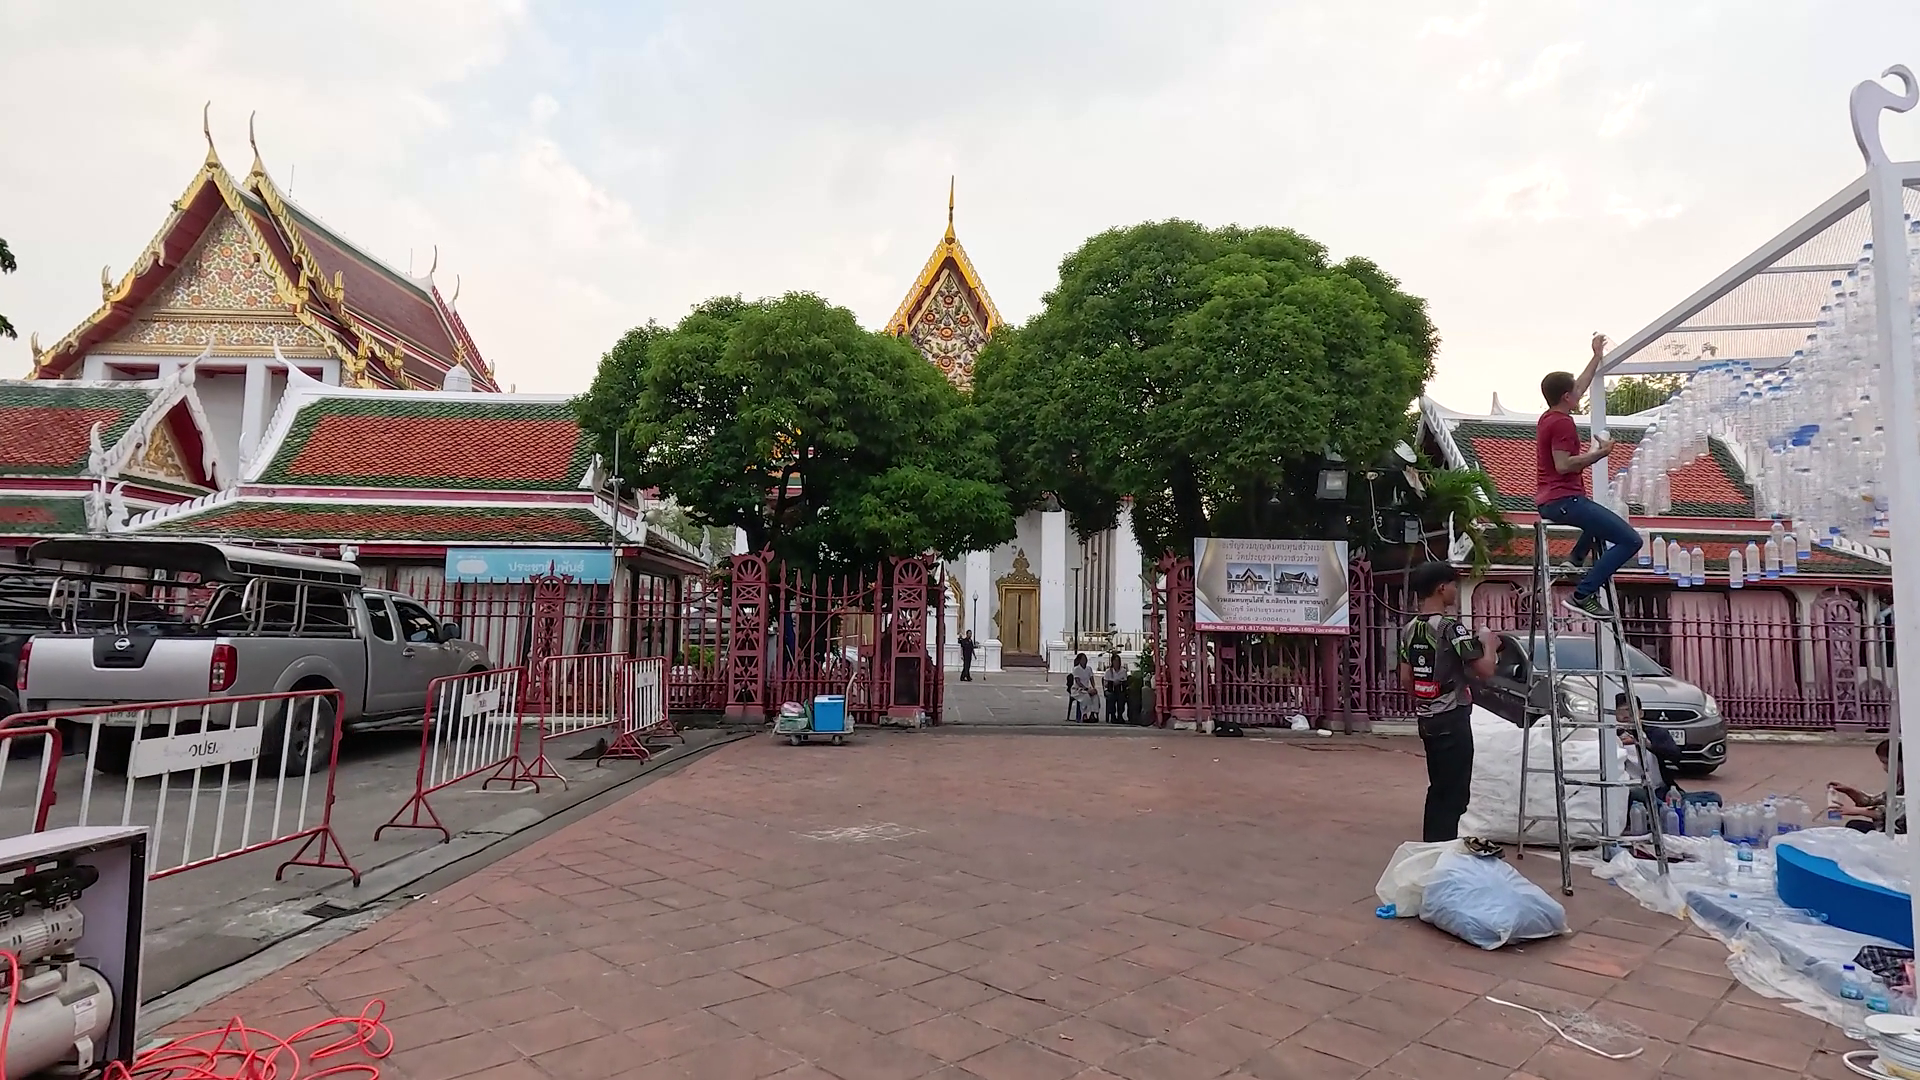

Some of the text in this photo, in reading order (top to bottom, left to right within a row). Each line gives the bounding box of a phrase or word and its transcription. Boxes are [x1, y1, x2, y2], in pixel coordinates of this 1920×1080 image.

[508, 561, 584, 572] ประชาสมพันธ์
[188, 740, 218, 757] วปย.
